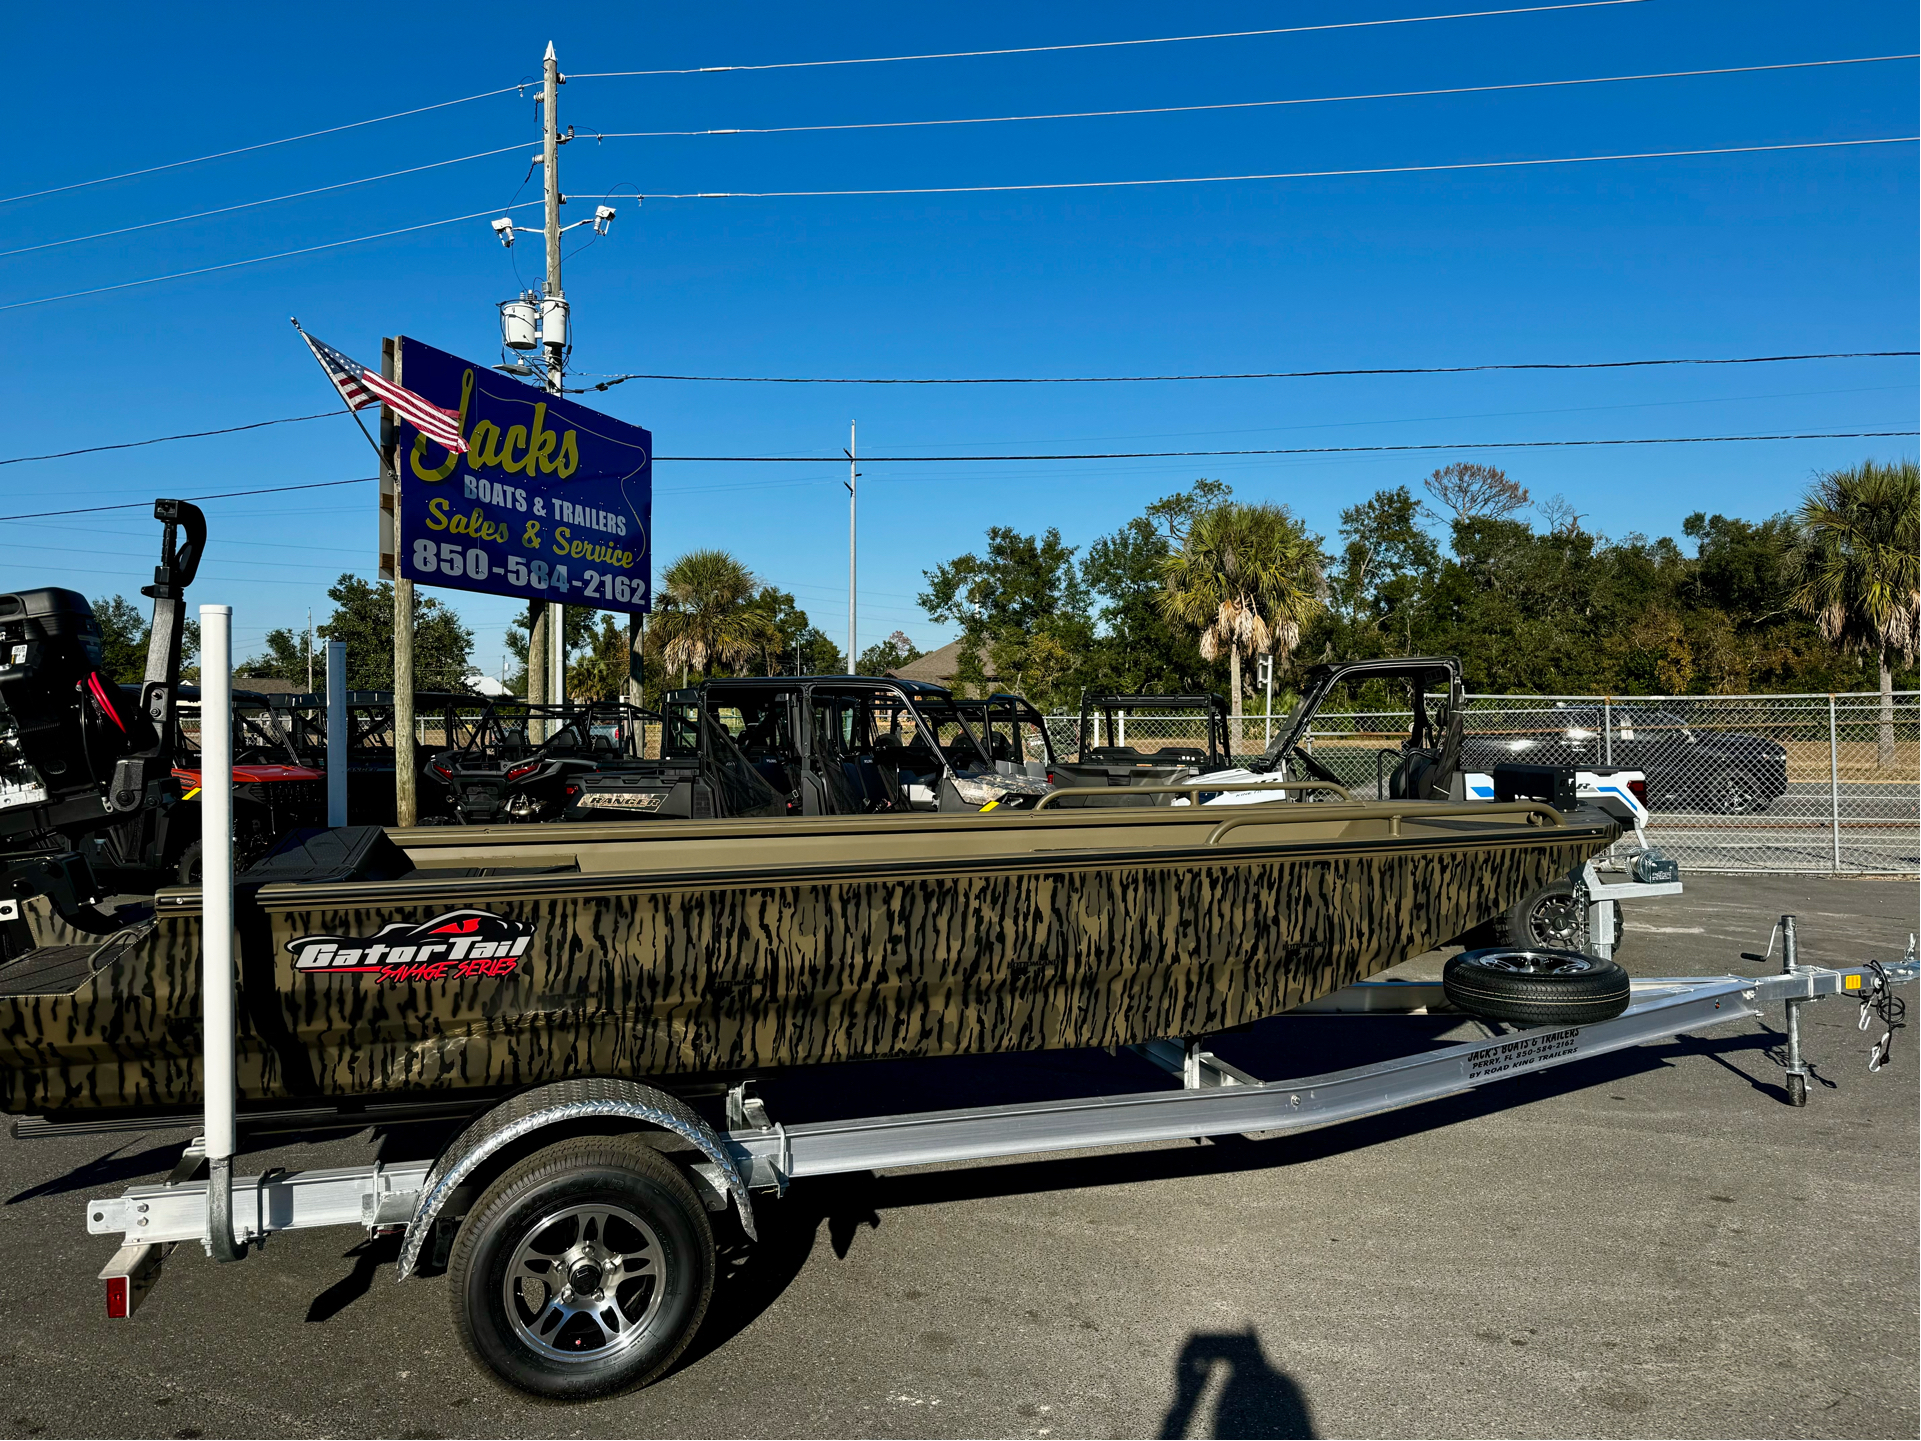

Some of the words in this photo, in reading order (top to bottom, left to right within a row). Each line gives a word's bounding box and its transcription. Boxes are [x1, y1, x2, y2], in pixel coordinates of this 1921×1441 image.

[410, 368, 579, 482] Jacks
[463, 474, 527, 512] BOATS
[532, 497, 547, 517] &
[552, 498, 626, 536] TRAILERS
[425, 497, 509, 543] Sales
[522, 520, 541, 549] &
[552, 526, 634, 568] Service
[412, 538, 646, 605] 850-584-2162
[589, 797, 661, 807] RANGER
[295, 936, 532, 969] GatorTail
[375, 960, 459, 984] SAVAGE
[452, 957, 519, 980] SERIES
[709, 978, 768, 989] OTTOMLAND
[1467, 1047, 1499, 1062] JACK'S
[1501, 1040, 1529, 1054] BOATS
[1531, 1038, 1538, 1046] &
[1541, 1027, 1580, 1044] TRAILERS
[1472, 1056, 1501, 1069] PERRY,
[1504, 1053, 1514, 1061] FL
[1515, 1039, 1575, 1059] 850-584-2162
[1469, 1070, 1482, 1079] BY
[1484, 1064, 1509, 1076] ROAD
[1512, 1057, 1535, 1069] KING
[1538, 1047, 1579, 1062] TRAILERS
